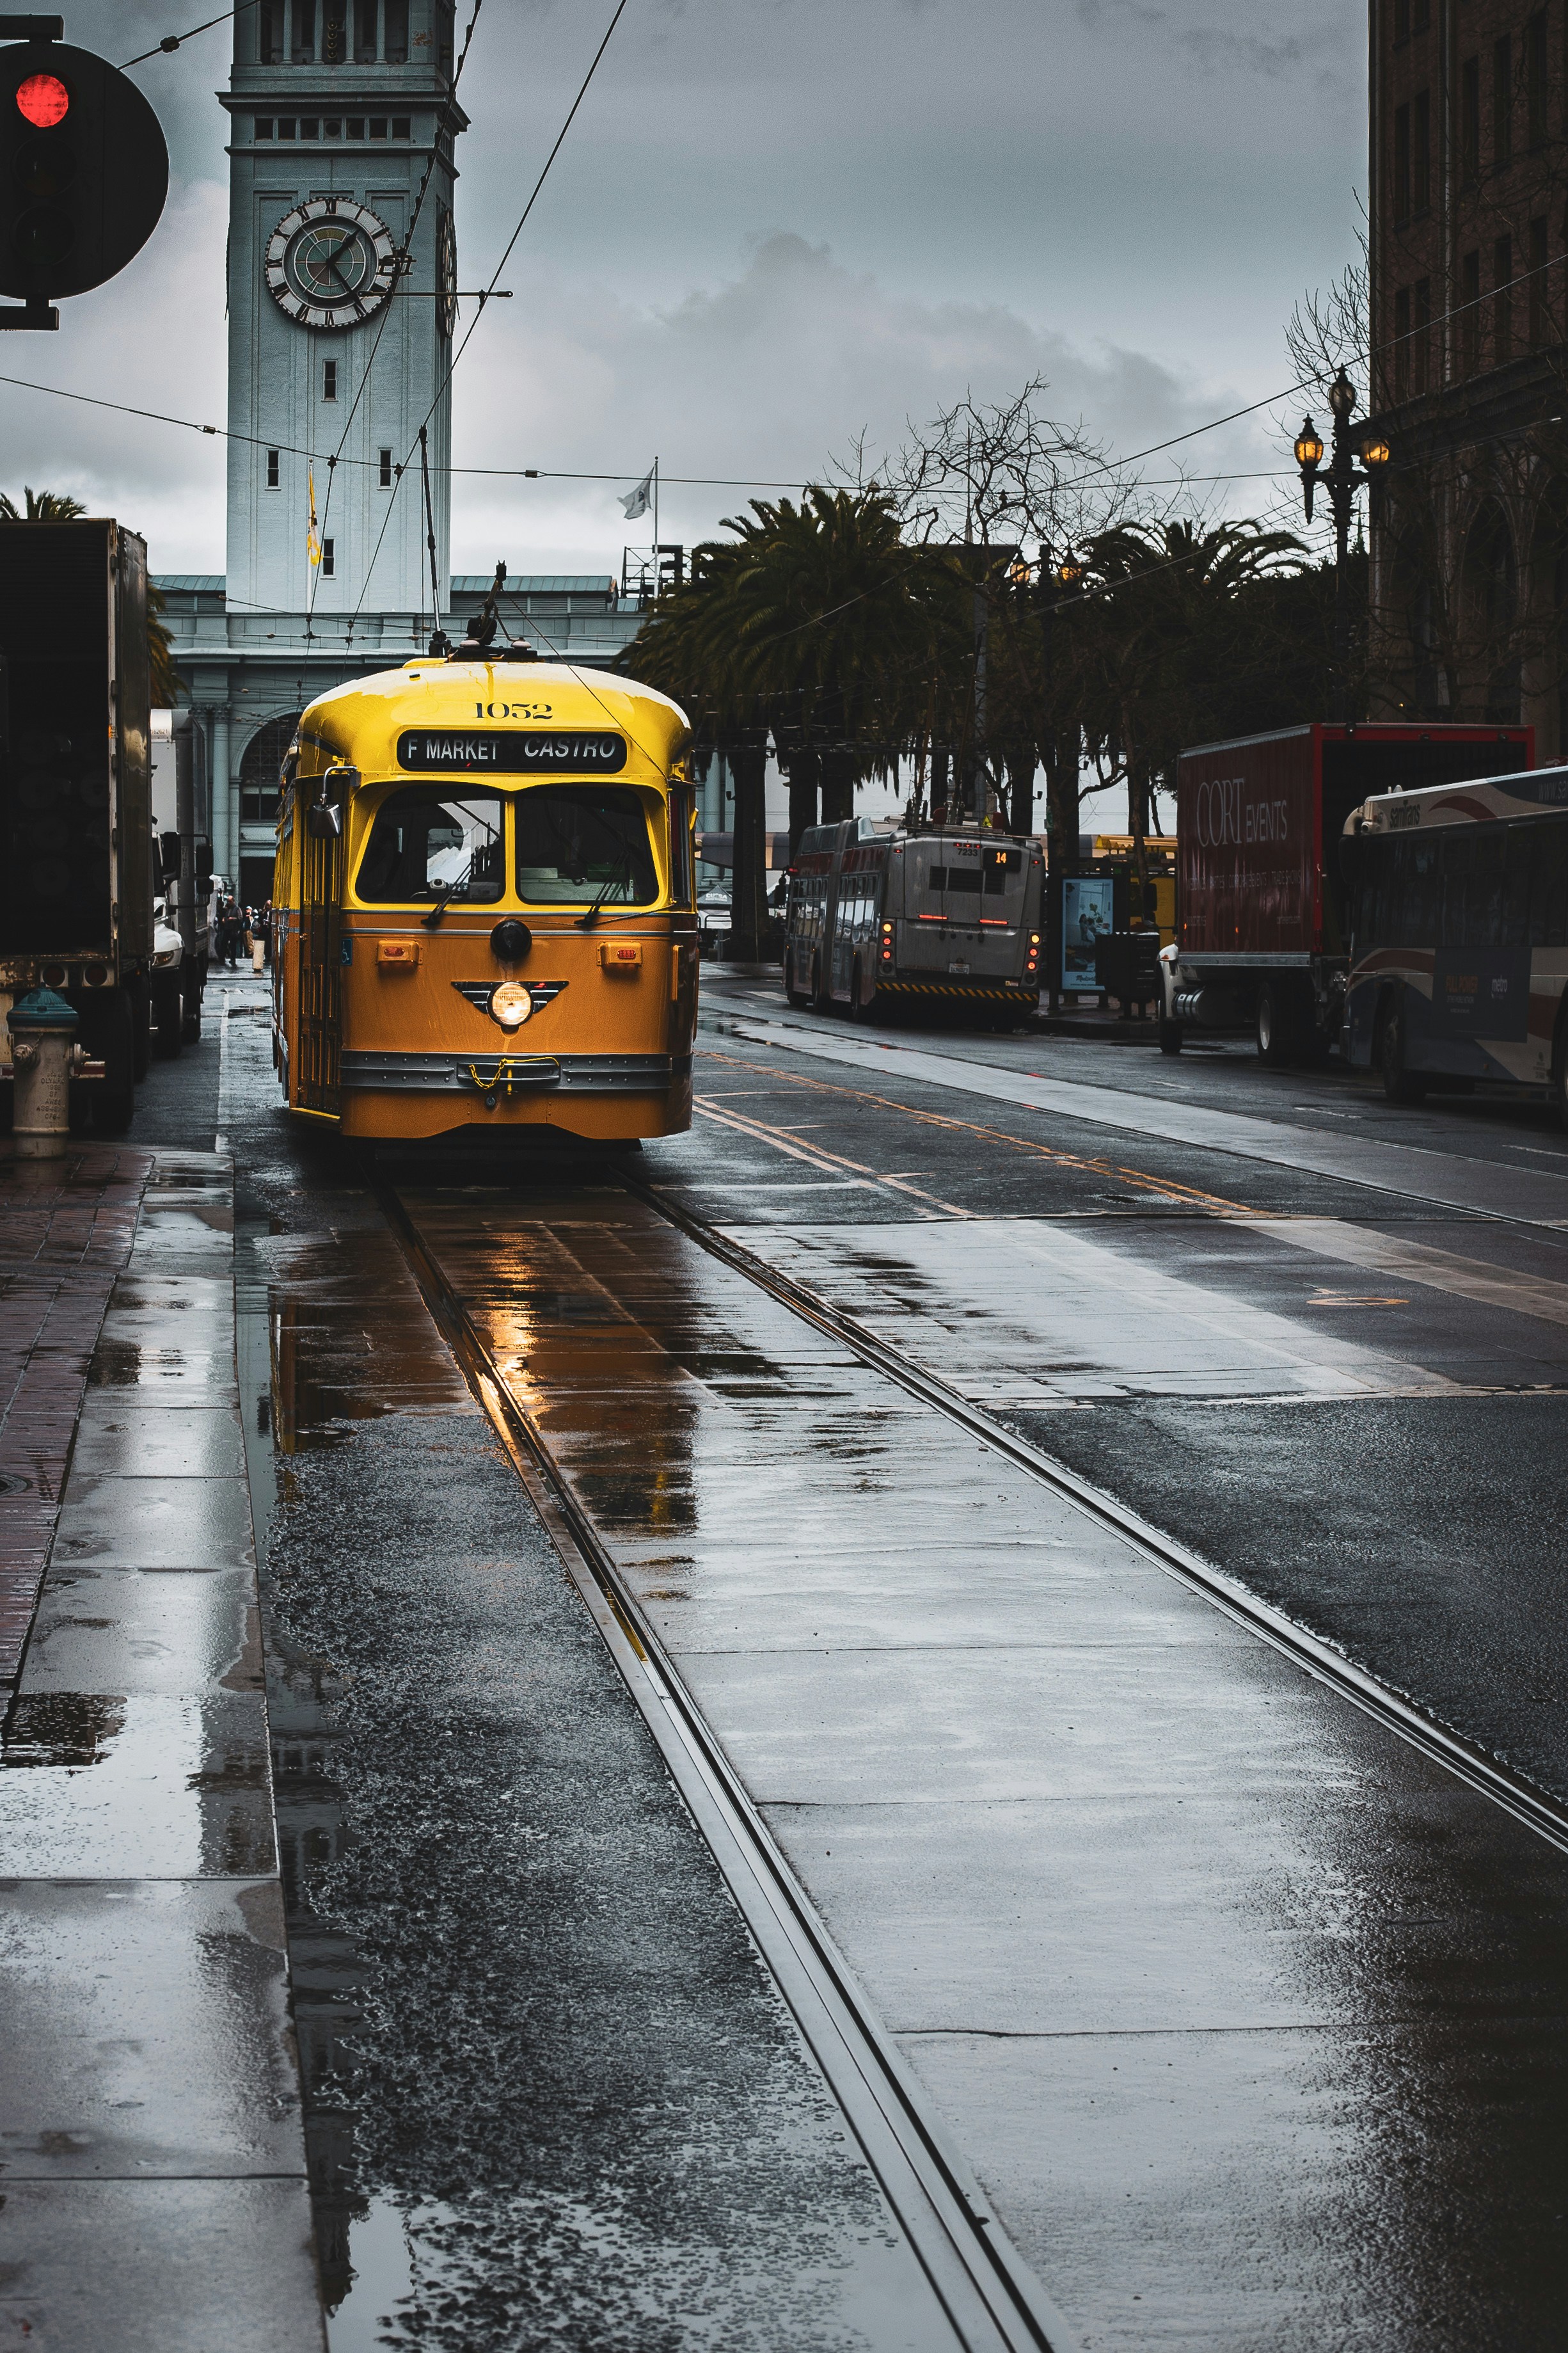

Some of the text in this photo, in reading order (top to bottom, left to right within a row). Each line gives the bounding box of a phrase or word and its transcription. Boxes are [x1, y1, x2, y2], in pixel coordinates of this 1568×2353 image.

[473, 702, 553, 719] 1052
[408, 737, 616, 760] F MARKET CASTRO
[1538, 780, 1568, 801] www.sa
[1196, 778, 1288, 847] CORT EVENTS
[1389, 800, 1421, 828] samTrans
[958, 849, 978, 857] 7233
[995, 852, 1007, 863] 14
